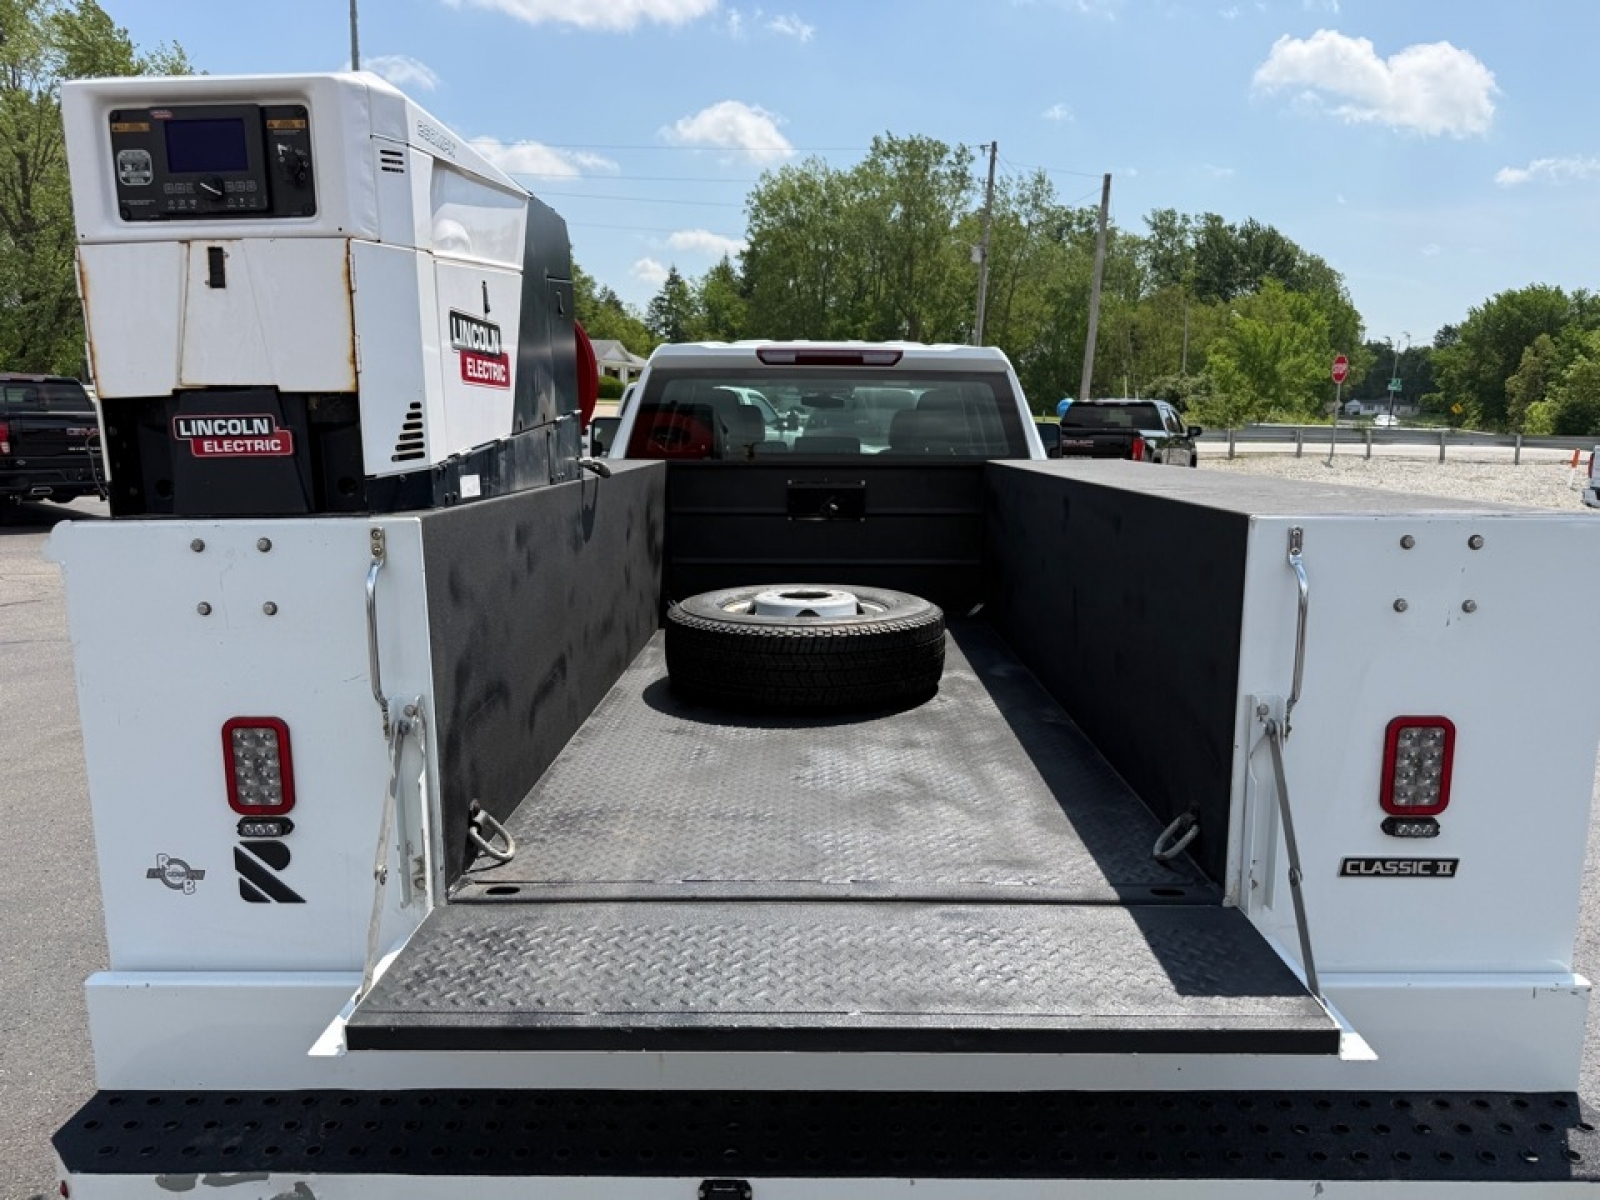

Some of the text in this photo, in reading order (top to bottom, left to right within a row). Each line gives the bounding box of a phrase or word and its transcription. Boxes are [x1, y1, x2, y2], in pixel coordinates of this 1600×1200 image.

[452, 317, 501, 355] LINCOLN
[466, 357, 506, 382] ELECTRIC
[179, 418, 269, 436] LINCOLN
[203, 439, 281, 453] ELECTRIC
[1345, 861, 1454, 875] CLASSIC II
